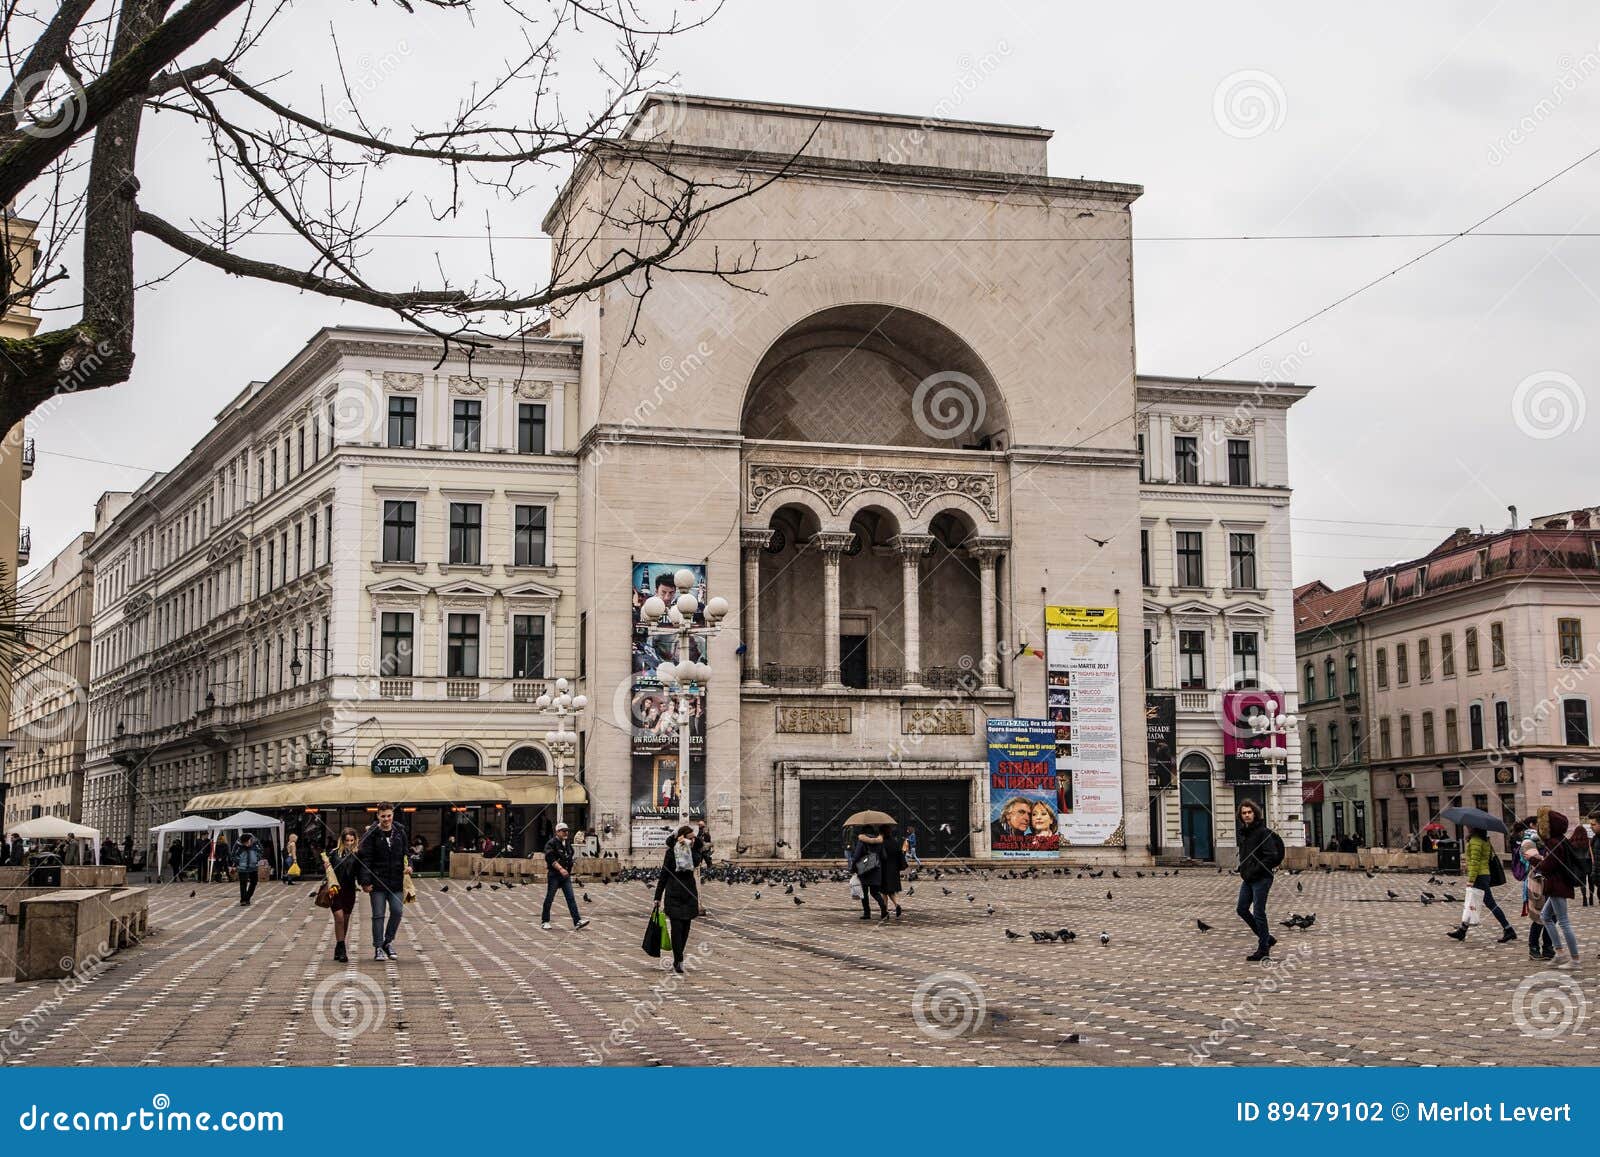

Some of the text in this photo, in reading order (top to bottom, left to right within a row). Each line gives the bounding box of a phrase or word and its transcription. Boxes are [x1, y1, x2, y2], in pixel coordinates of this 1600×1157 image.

[377, 758, 422, 766] SYMPHONY
[637, 806, 701, 814] ANNA KARENA
